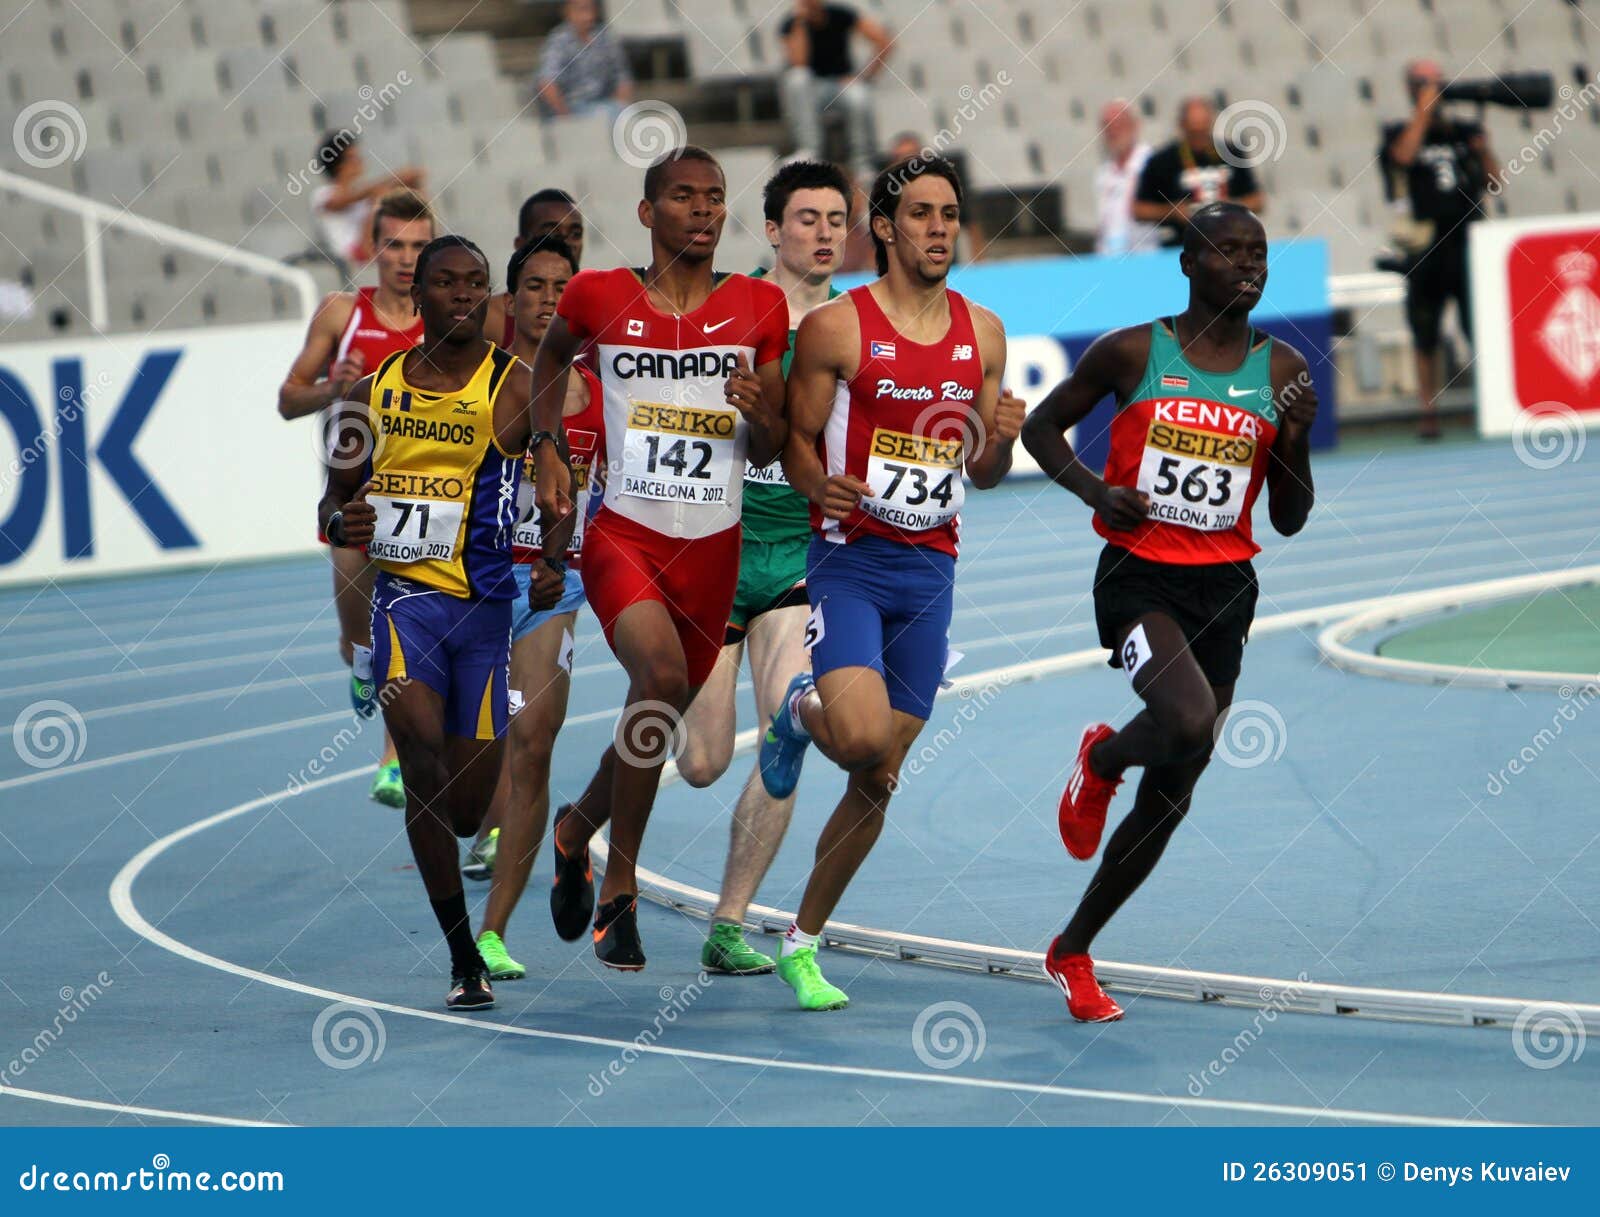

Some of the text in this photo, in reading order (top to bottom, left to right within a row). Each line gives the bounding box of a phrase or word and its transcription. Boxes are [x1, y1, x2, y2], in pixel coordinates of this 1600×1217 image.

[612, 352, 738, 380] CANADA
[876, 379, 974, 400] Puerto Rico
[381, 414, 475, 446] BARBADOS
[631, 404, 734, 436] SEIKO
[1154, 401, 1258, 440] KENYA
[645, 435, 713, 479] 142
[1151, 424, 1254, 463] SEIKO
[369, 472, 464, 499] SEIKO
[625, 478, 724, 502] BARCELONA 2012
[881, 463, 954, 508] 734
[1153, 457, 1232, 507] 563
[391, 501, 430, 539] 71
[862, 502, 932, 528] BARCELONA
[1149, 502, 1235, 528] RCELONA 2012
[426, 543, 450, 559] 2012
[1124, 640, 1139, 672] 8
